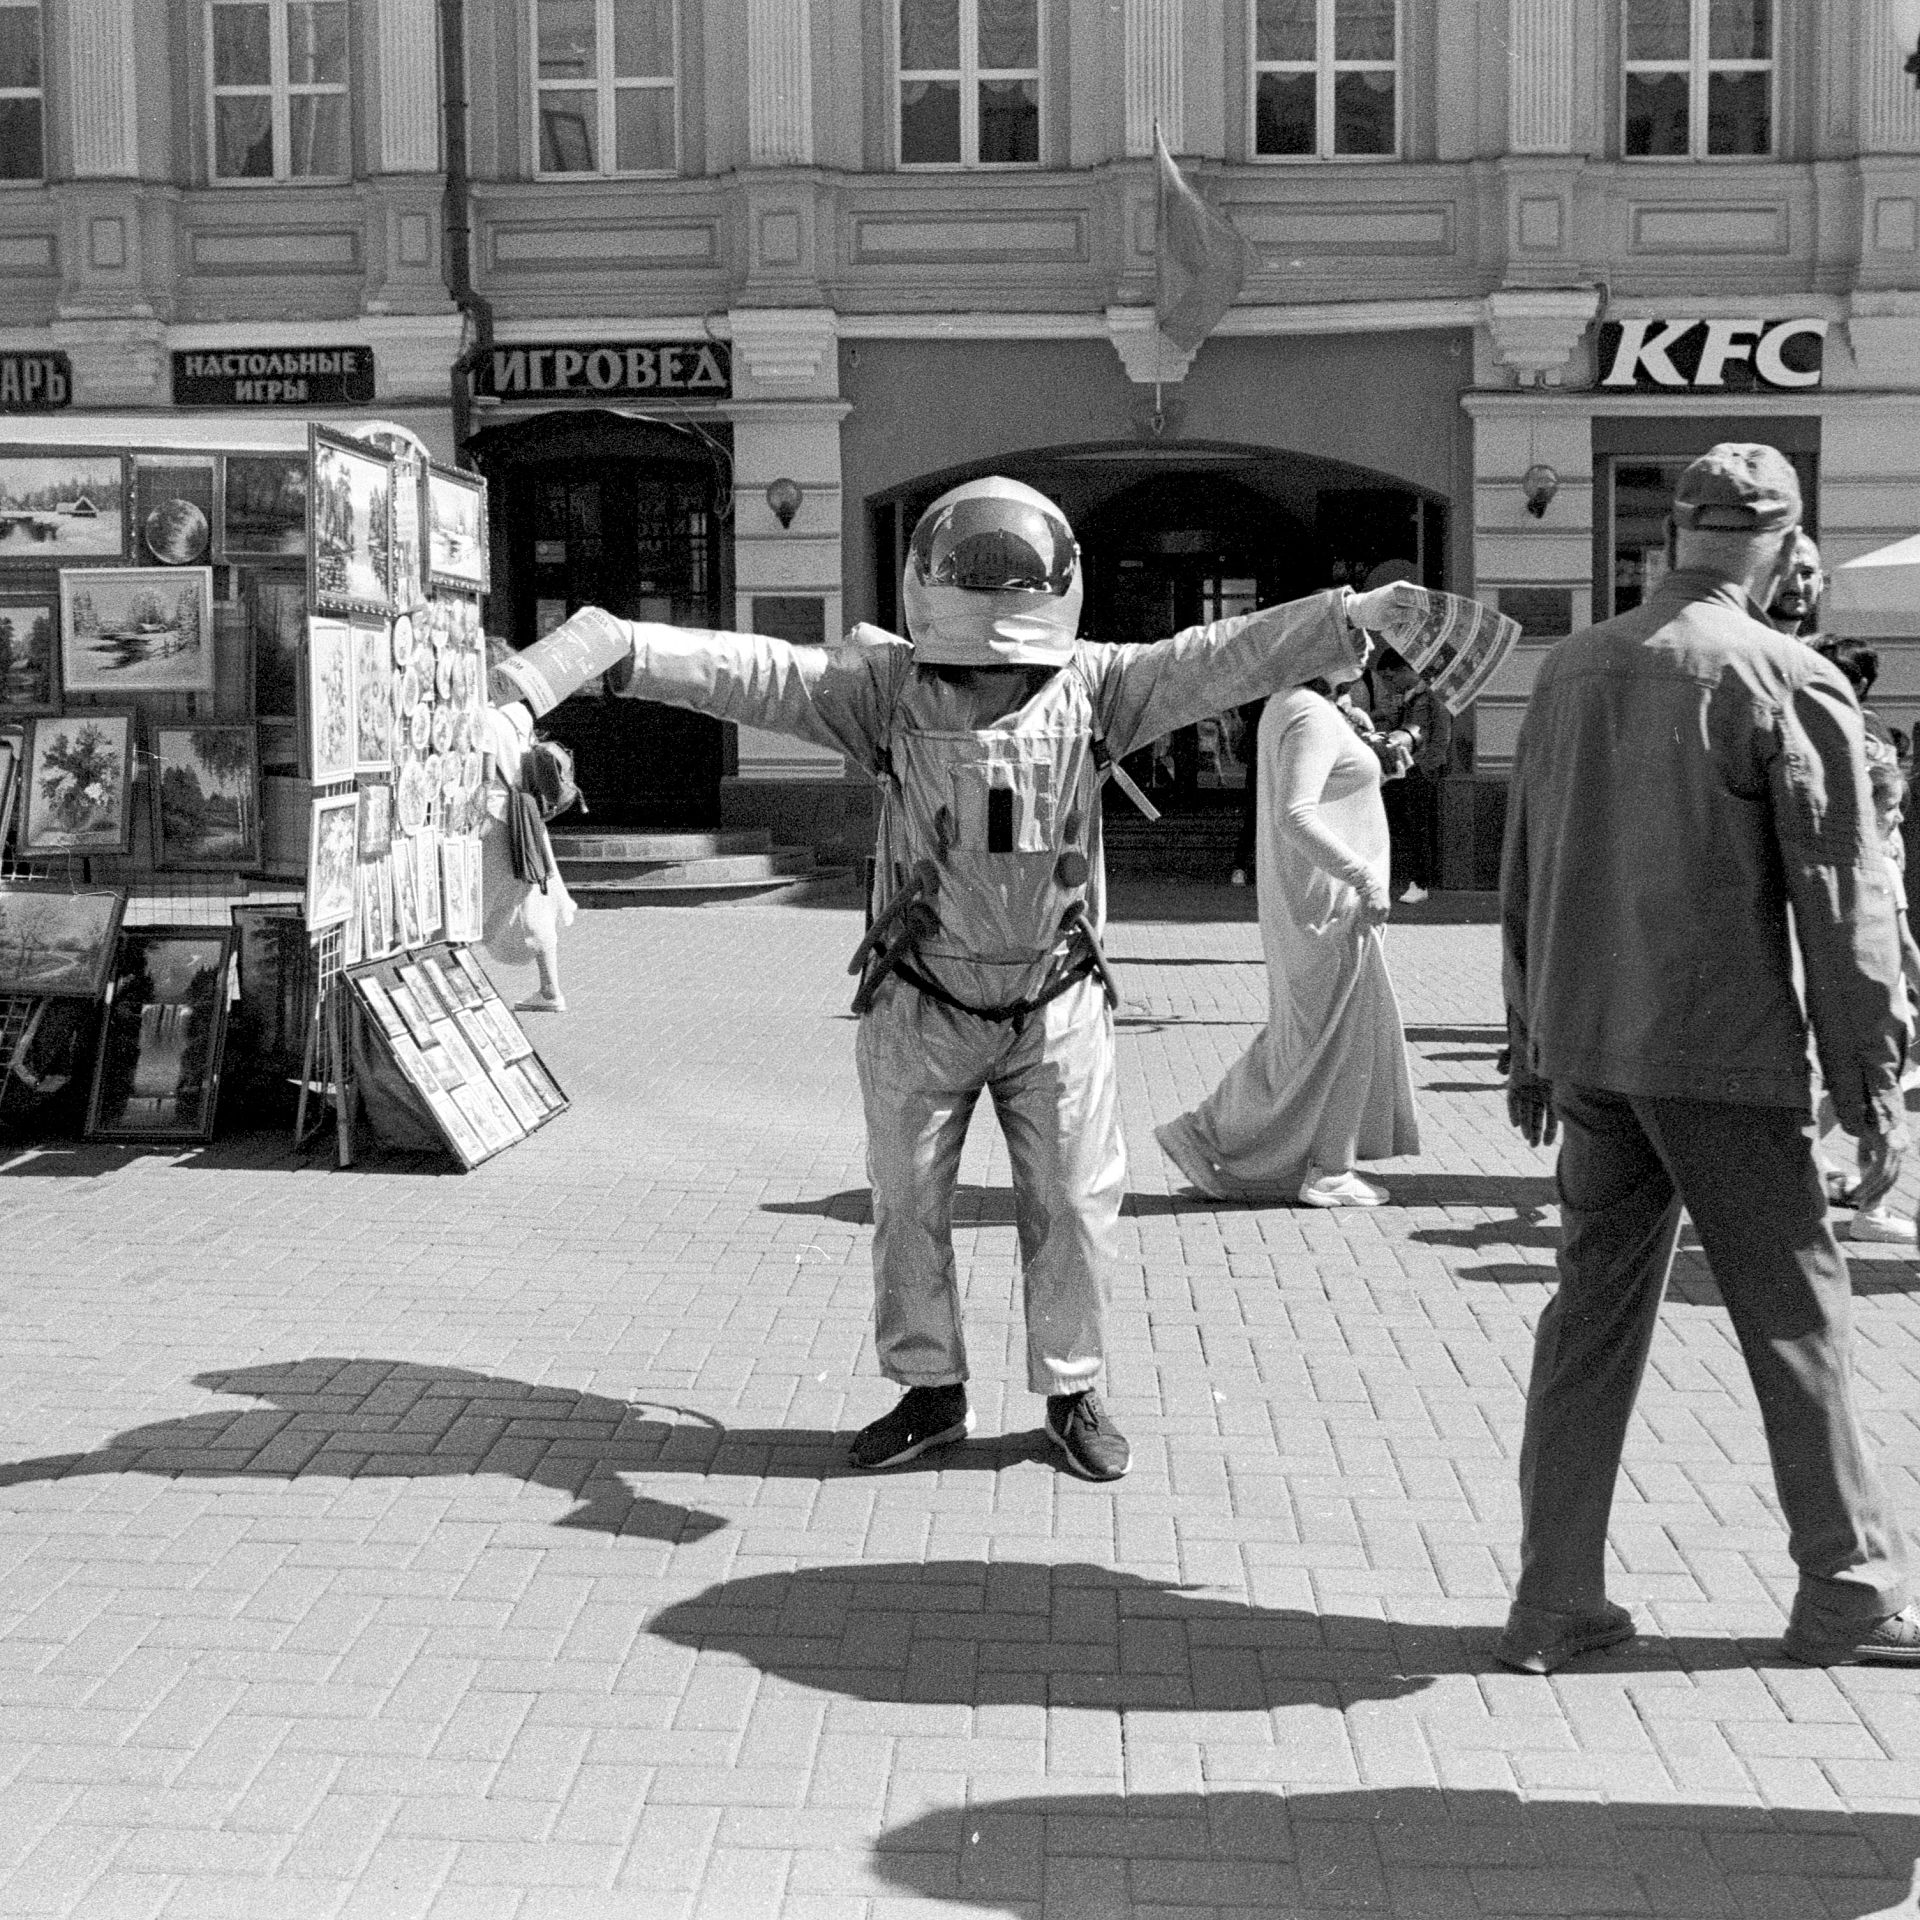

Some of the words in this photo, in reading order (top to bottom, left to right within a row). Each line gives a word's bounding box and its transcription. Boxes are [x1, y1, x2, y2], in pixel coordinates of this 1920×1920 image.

[185, 352, 358, 376] НАСТОЛЬНЫЕ
[493, 346, 727, 391] ИГРОВЕД
[1602, 318, 1829, 387] KFC
[235, 380, 308, 401] ИГРЫ
